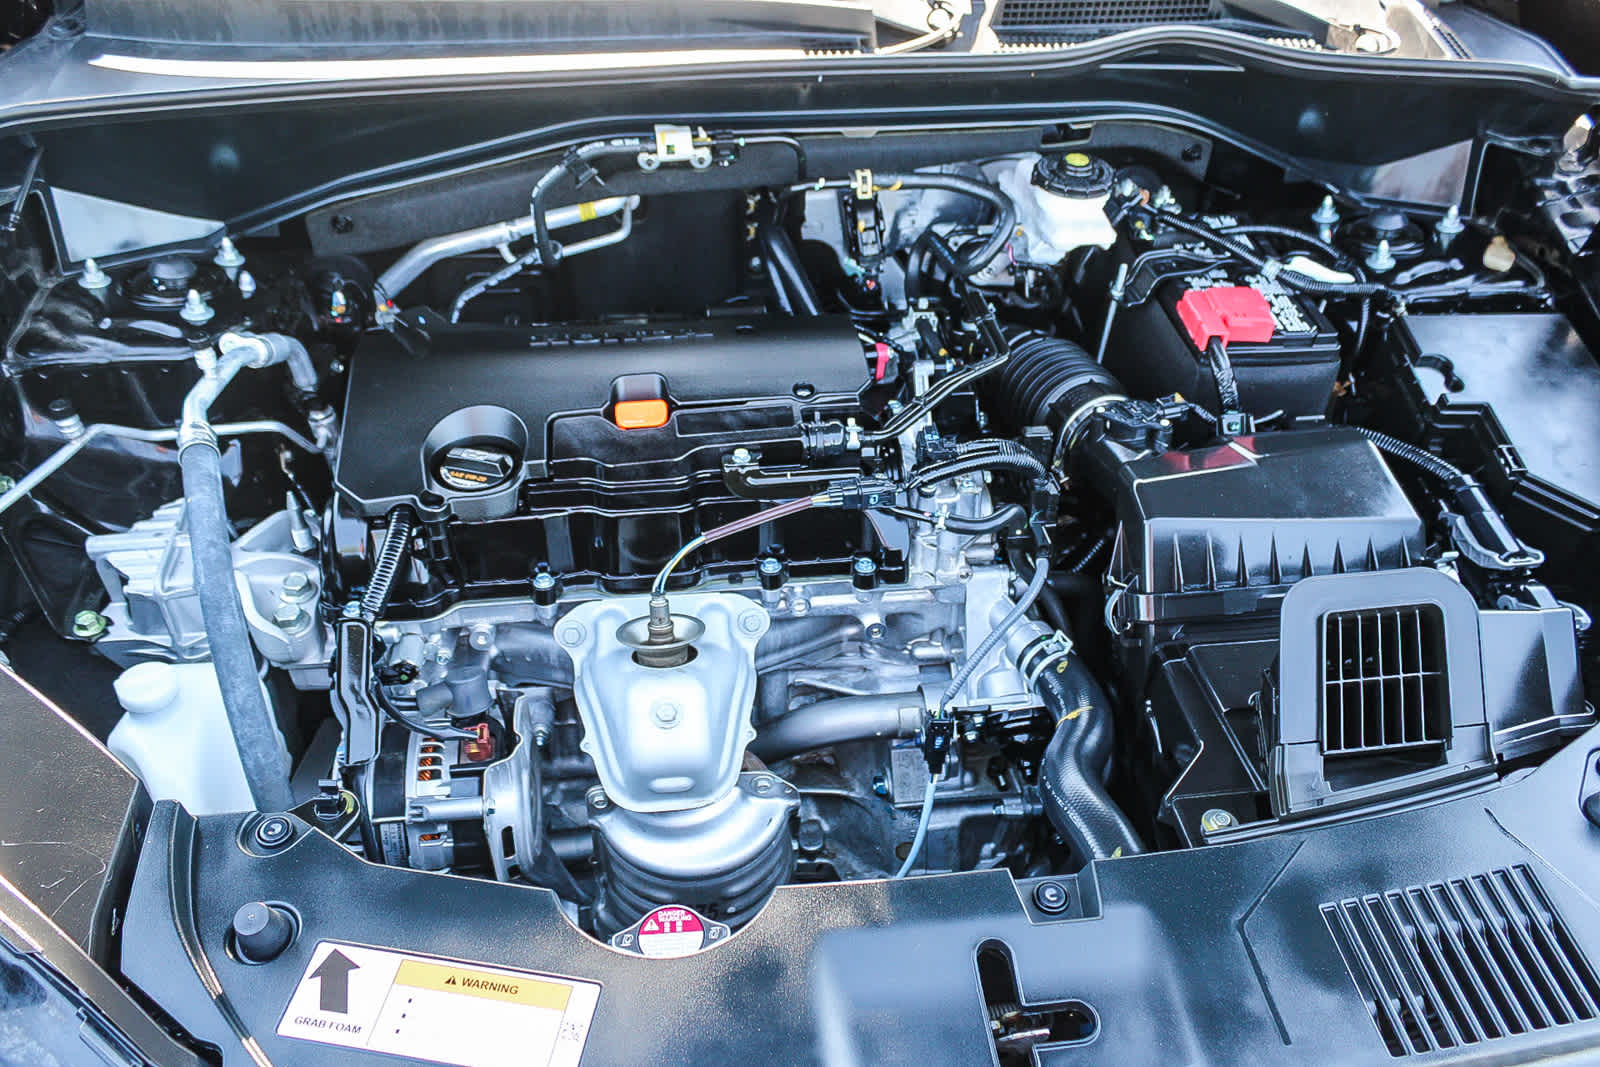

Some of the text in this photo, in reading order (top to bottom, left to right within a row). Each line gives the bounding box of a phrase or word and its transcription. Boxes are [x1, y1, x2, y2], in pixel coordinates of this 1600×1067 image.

[462, 977, 519, 995] WARNING
[294, 1015, 362, 1034] GRAB FOAM
